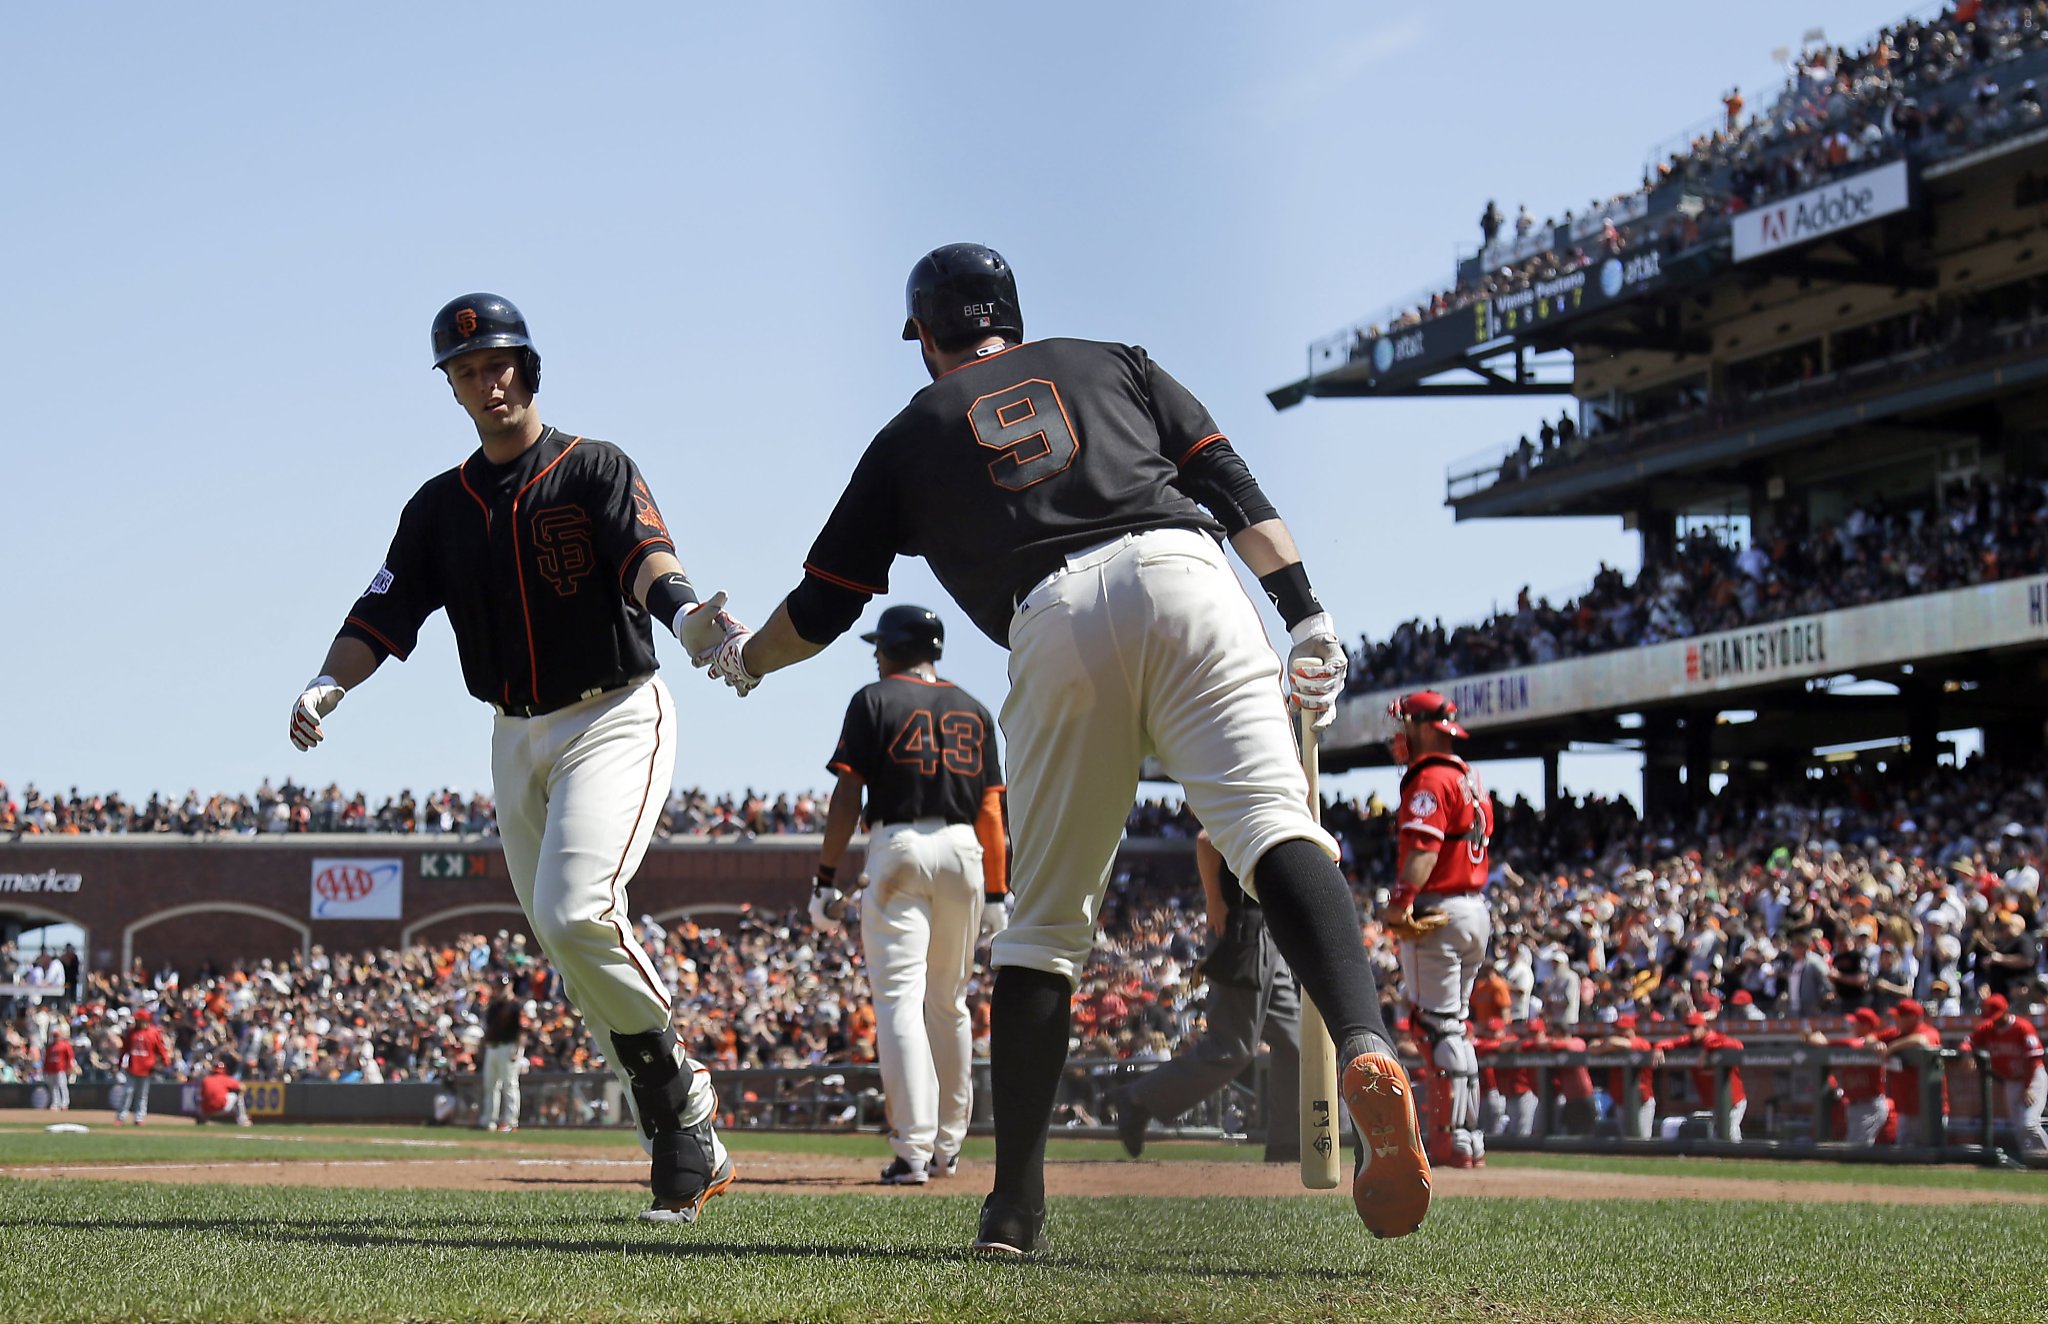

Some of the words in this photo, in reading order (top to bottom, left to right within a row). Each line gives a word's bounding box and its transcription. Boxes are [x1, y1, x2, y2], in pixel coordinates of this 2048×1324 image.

[1793, 186, 1874, 236] Adobe
[963, 302, 995, 317] BELT
[967, 378, 1080, 492] 9
[531, 504, 595, 597] SF
[1498, 674, 1529, 711] RUN
[888, 708, 984, 778] 43
[316, 865, 373, 903] AAA
